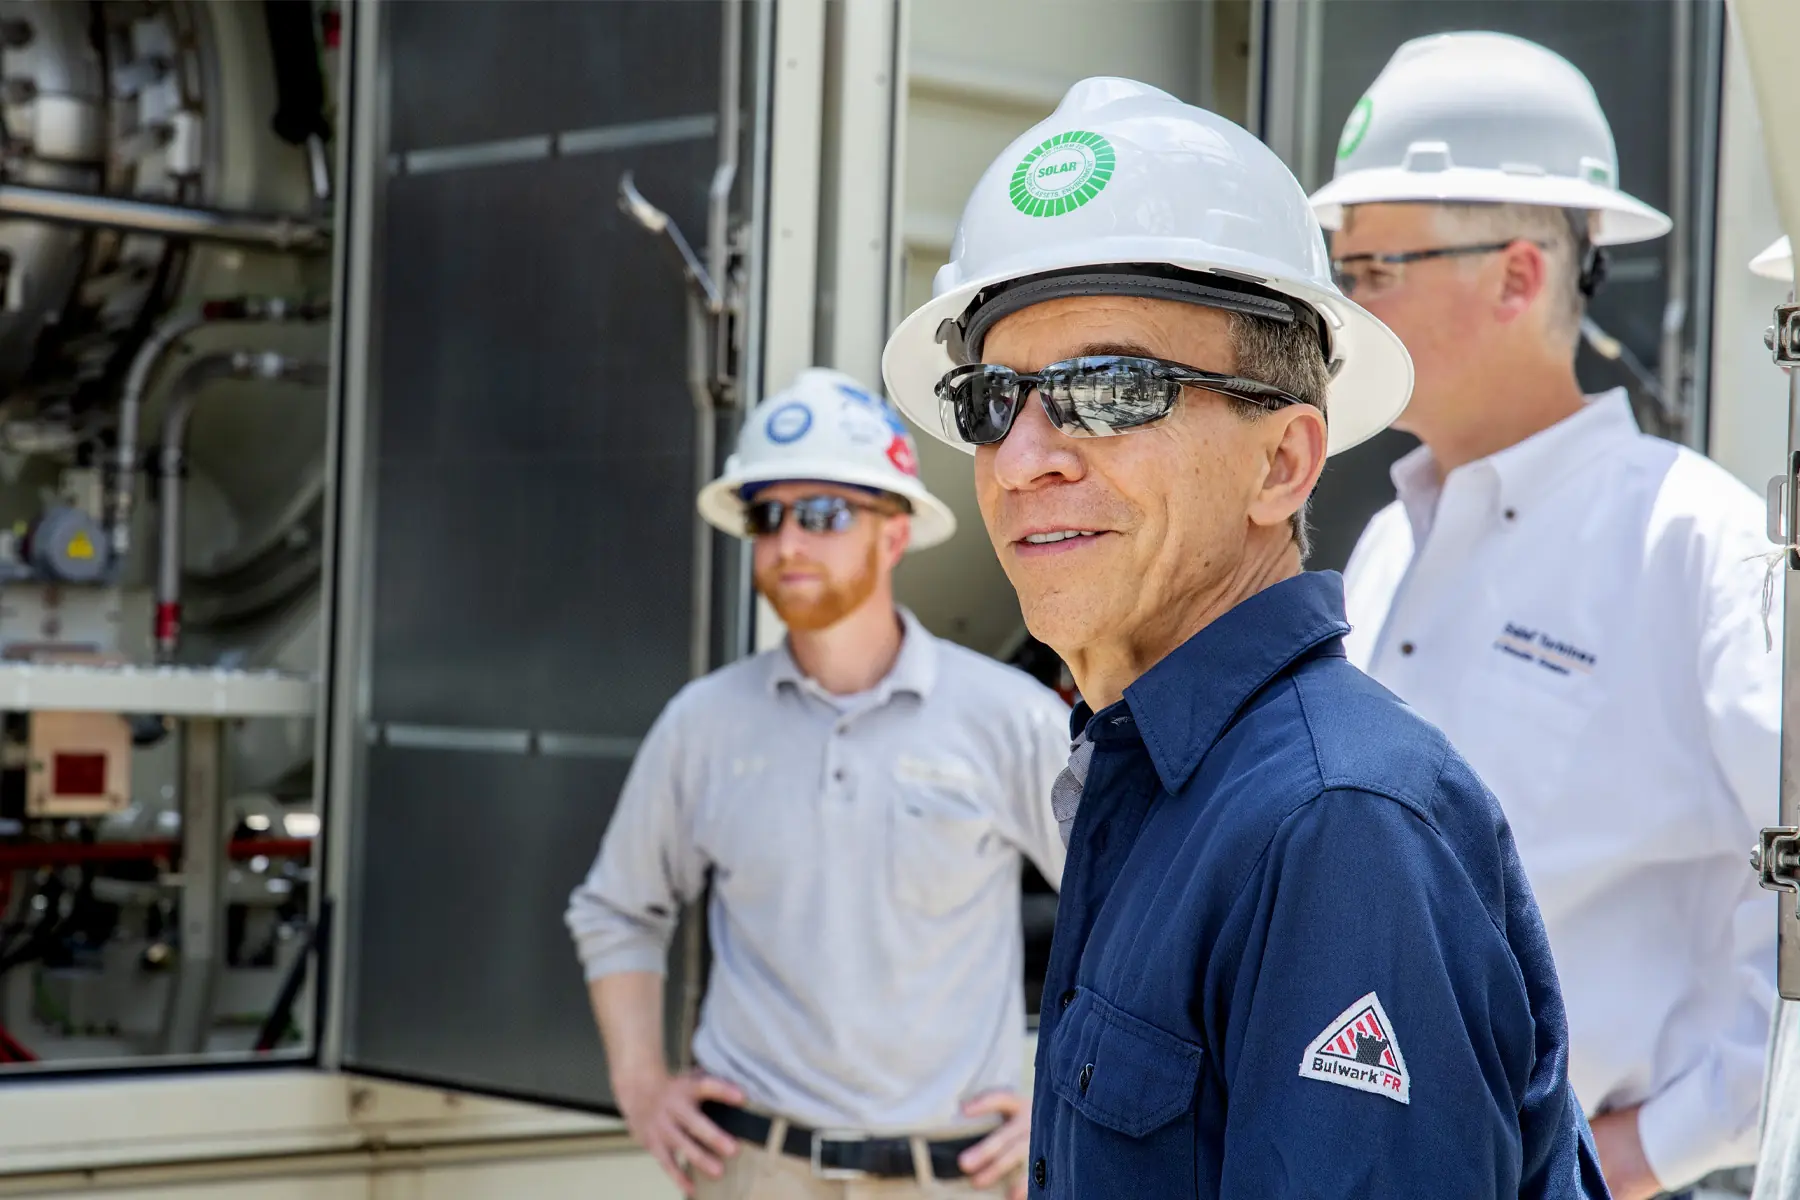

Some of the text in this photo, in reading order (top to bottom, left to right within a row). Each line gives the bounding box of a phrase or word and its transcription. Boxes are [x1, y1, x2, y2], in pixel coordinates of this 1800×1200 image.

[1038, 162, 1077, 178] SOLAR
[1312, 1057, 1402, 1093] Bulwark FR
